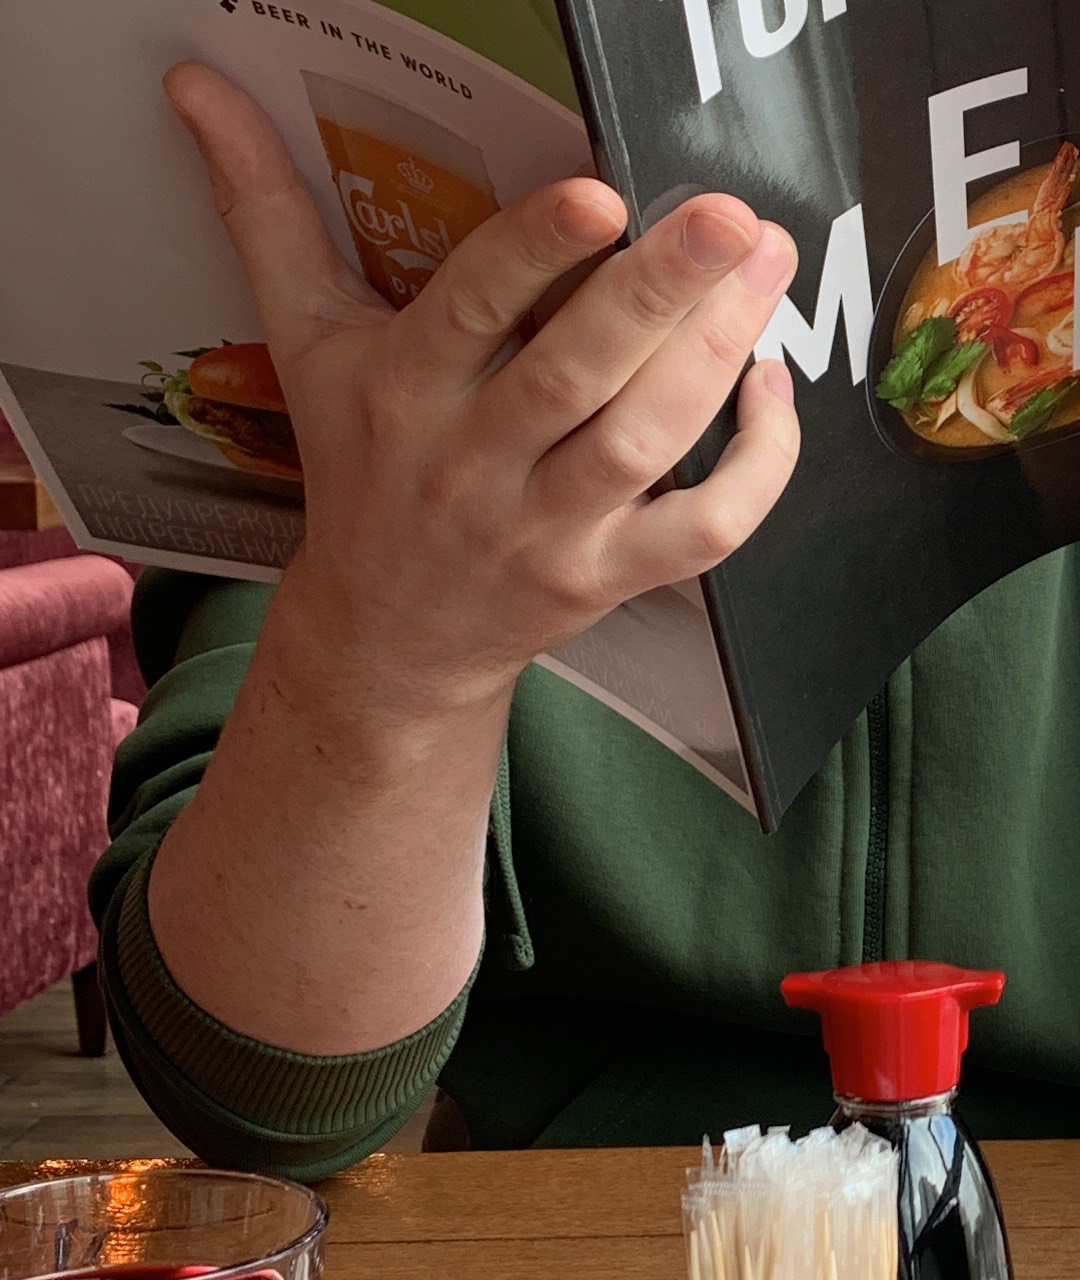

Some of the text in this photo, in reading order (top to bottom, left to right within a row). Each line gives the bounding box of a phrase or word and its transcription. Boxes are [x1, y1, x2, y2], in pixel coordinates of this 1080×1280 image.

[252, 0, 311, 29] BEER
[320, 20, 344, 41] IN
[351, 32, 392, 60] THE
[400, 53, 473, 100] WORLD
